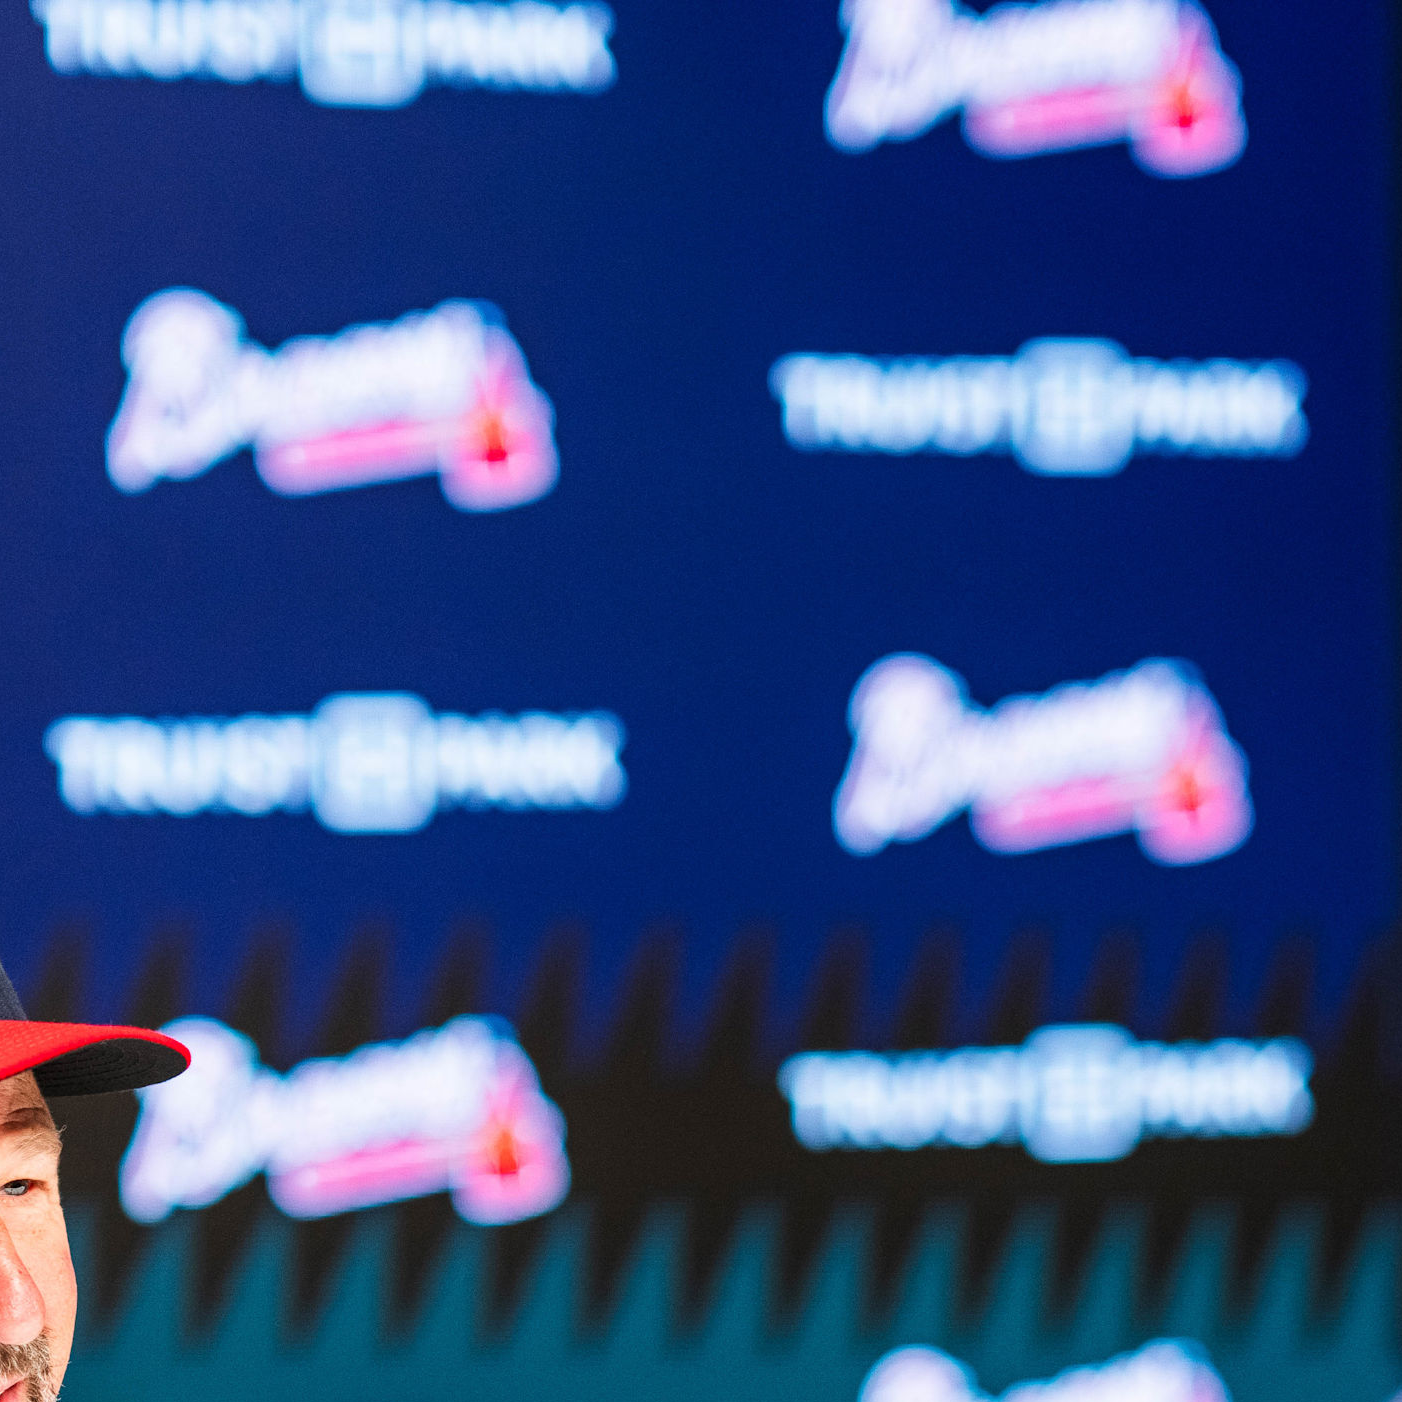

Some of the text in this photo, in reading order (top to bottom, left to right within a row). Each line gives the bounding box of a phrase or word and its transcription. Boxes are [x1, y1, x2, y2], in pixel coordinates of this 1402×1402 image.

[772, 353, 1307, 459] TRUIST PARK
[46, 711, 625, 815] TRUIST PARK
[779, 1038, 1313, 1151] TRUIST PARK
